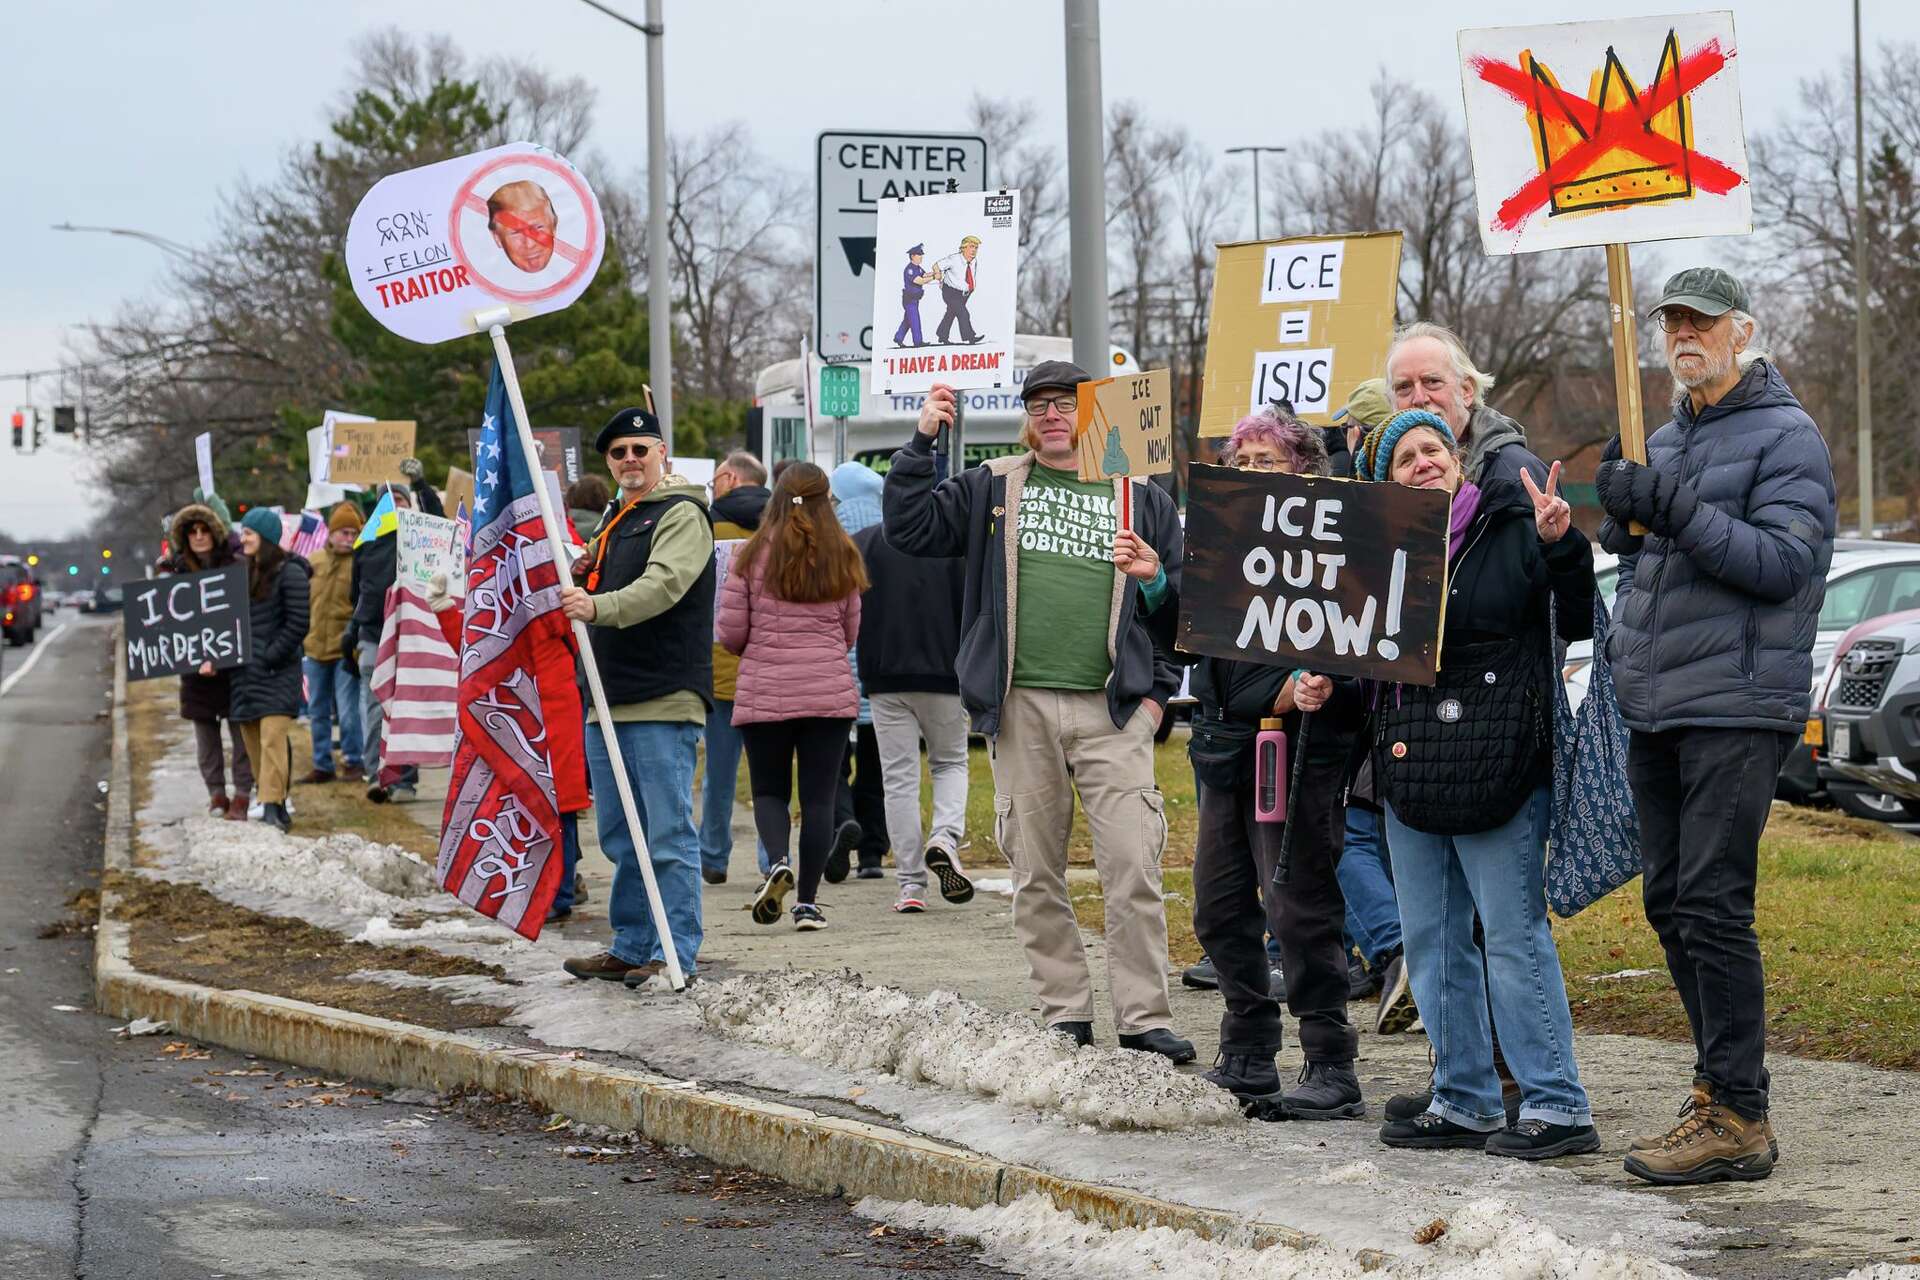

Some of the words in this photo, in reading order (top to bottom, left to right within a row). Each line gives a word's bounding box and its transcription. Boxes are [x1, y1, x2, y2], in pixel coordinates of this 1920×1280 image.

[839, 143, 966, 172] CENTER
[859, 179, 946, 203] LANE
[380, 222, 430, 246] MAN
[384, 242, 449, 272] FELON
[376, 265, 471, 308] TRAITOR
[900, 356, 935, 374] HAVE
[938, 354, 948, 372] A
[1132, 378, 1151, 400] ICE
[824, 400, 858, 413] 1003
[1140, 406, 1162, 431] OUT
[1147, 434, 1171, 464] NOW!
[1019, 500, 1050, 513] FOR
[1057, 505, 1091, 526] THE
[1098, 516, 1117, 531] BI
[1262, 495, 1343, 541] ICE
[1017, 514, 1115, 548] BEAUTIFU
[1021, 532, 1114, 562] OBITUAR
[1243, 547, 1346, 590] OUT
[137, 573, 230, 627] ICE
[1236, 549, 1407, 661] NOW!
[128, 619, 243, 676] MURDERS!
